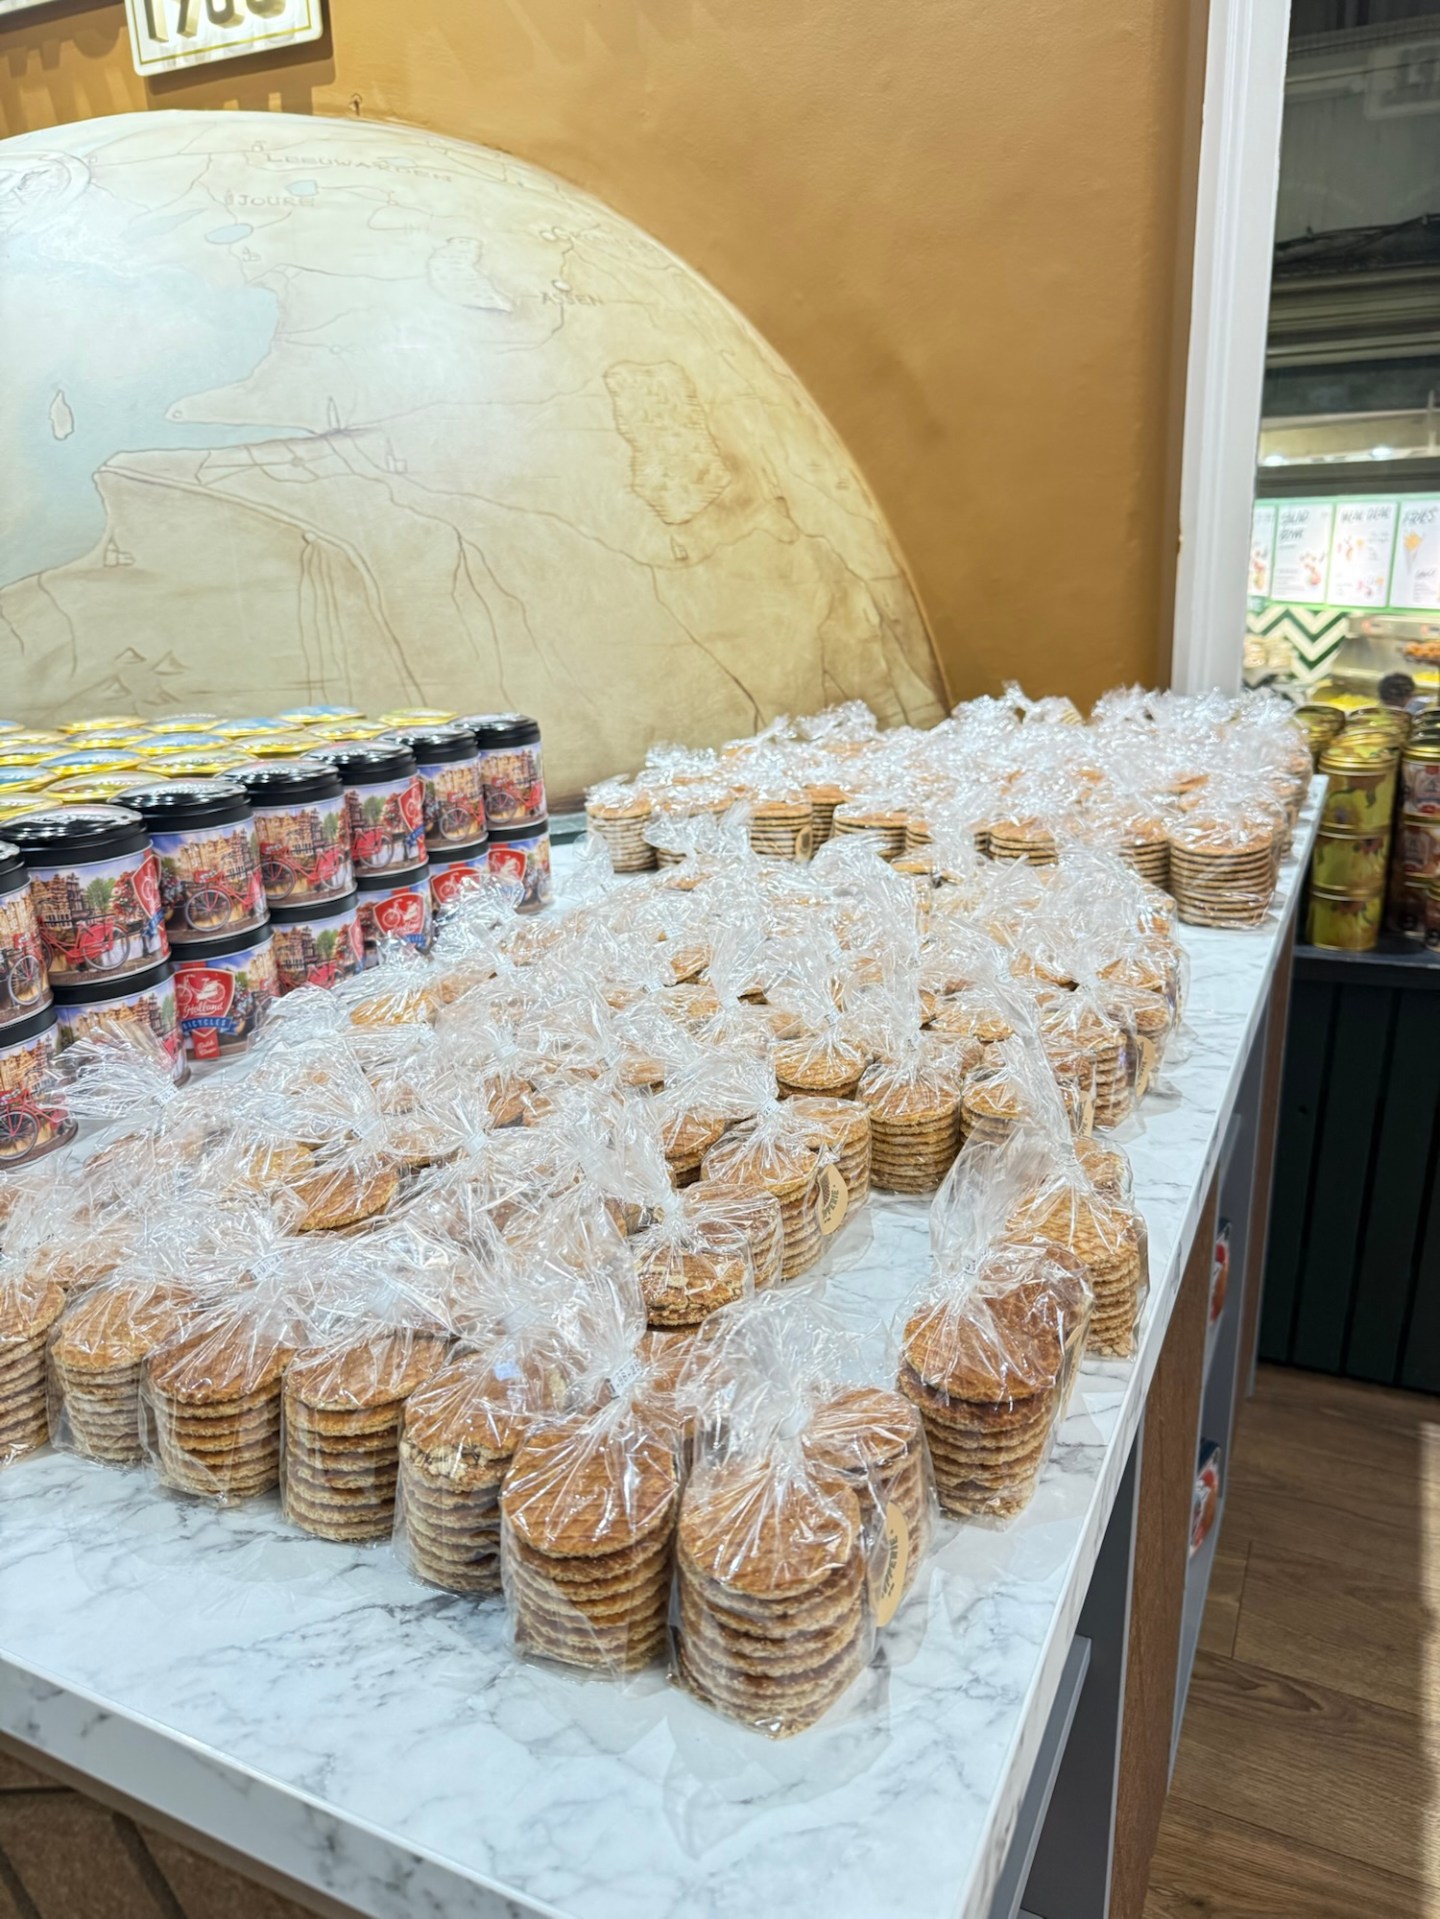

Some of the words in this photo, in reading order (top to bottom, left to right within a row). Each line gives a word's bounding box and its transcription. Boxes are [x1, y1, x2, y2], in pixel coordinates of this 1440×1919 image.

[239, 194, 316, 208] JOURE
[183, 1001, 224, 1019] Holland
[182, 1018, 228, 1030] BICYCLES
